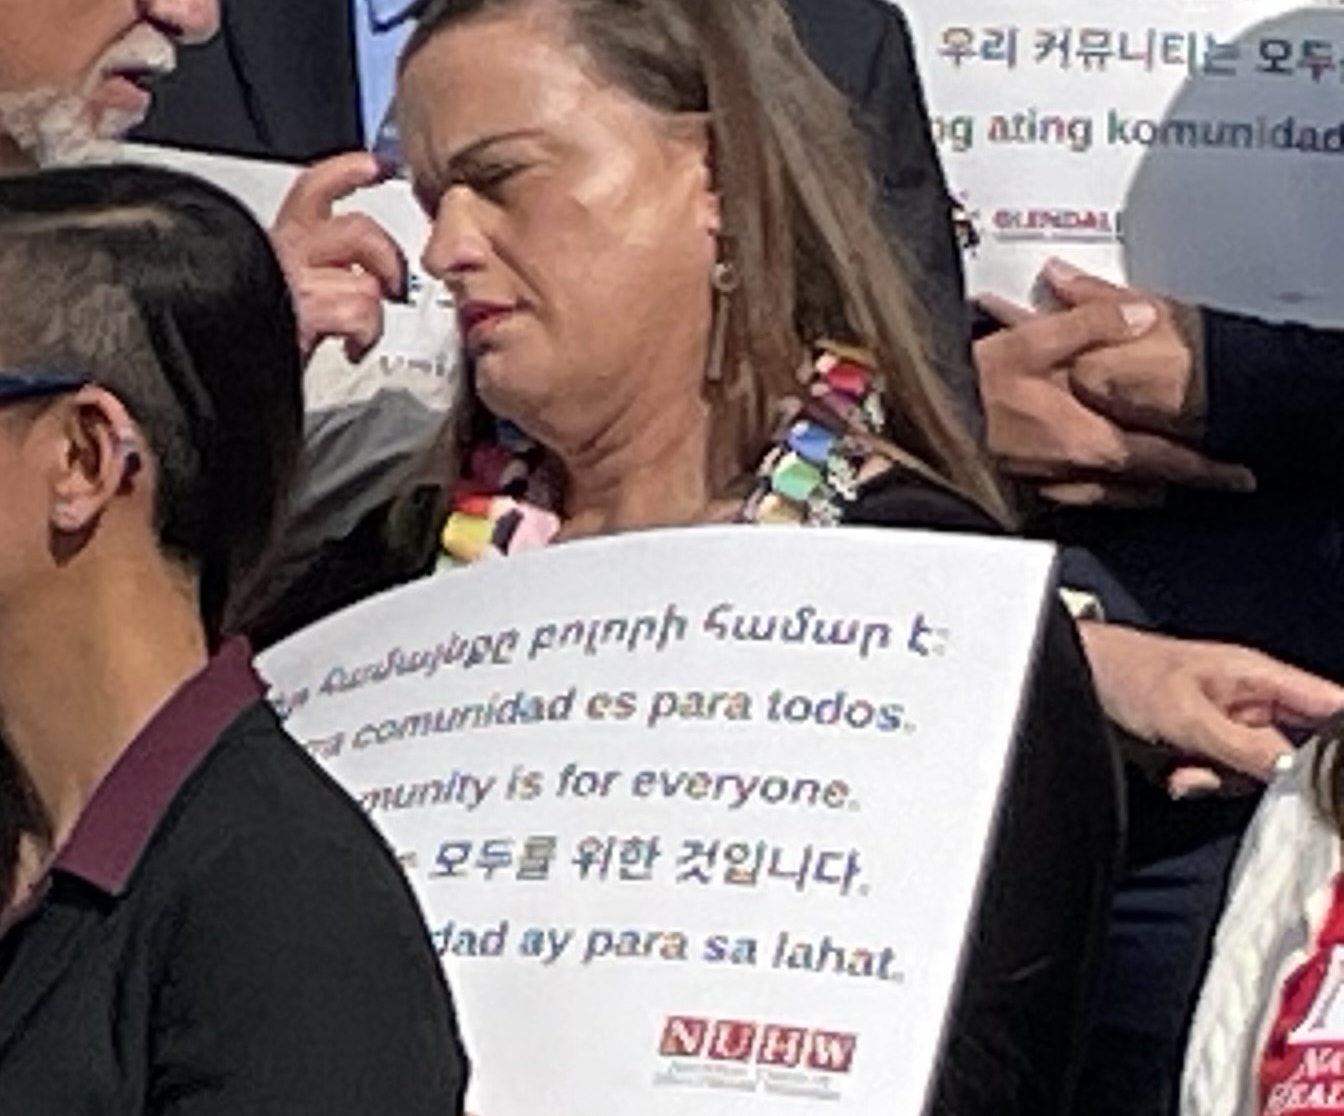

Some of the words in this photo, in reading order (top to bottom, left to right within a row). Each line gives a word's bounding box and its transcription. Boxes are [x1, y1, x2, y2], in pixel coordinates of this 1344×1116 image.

[937, 26, 1020, 70] 우리
[1034, 25, 1240, 77] 커뮤니티는
[932, 113, 973, 149] ng
[987, 107, 1094, 154] ating
[350, 687, 577, 752] comunidad
[585, 691, 638, 721] es
[646, 691, 753, 729] para
[766, 689, 917, 733] todos.
[361, 768, 498, 817] munity
[505, 765, 543, 801] is
[555, 762, 623, 798] for
[631, 762, 862, 811] everyone.
[427, 835, 558, 882] 모두를
[570, 835, 663, 882] 위한
[675, 839, 873, 897] 것입니다.
[518, 927, 575, 966] ay
[580, 928, 689, 966] para
[702, 934, 758, 966] sa
[771, 922, 906, 982] lahat.
[659, 1014, 859, 1075] NUHW
